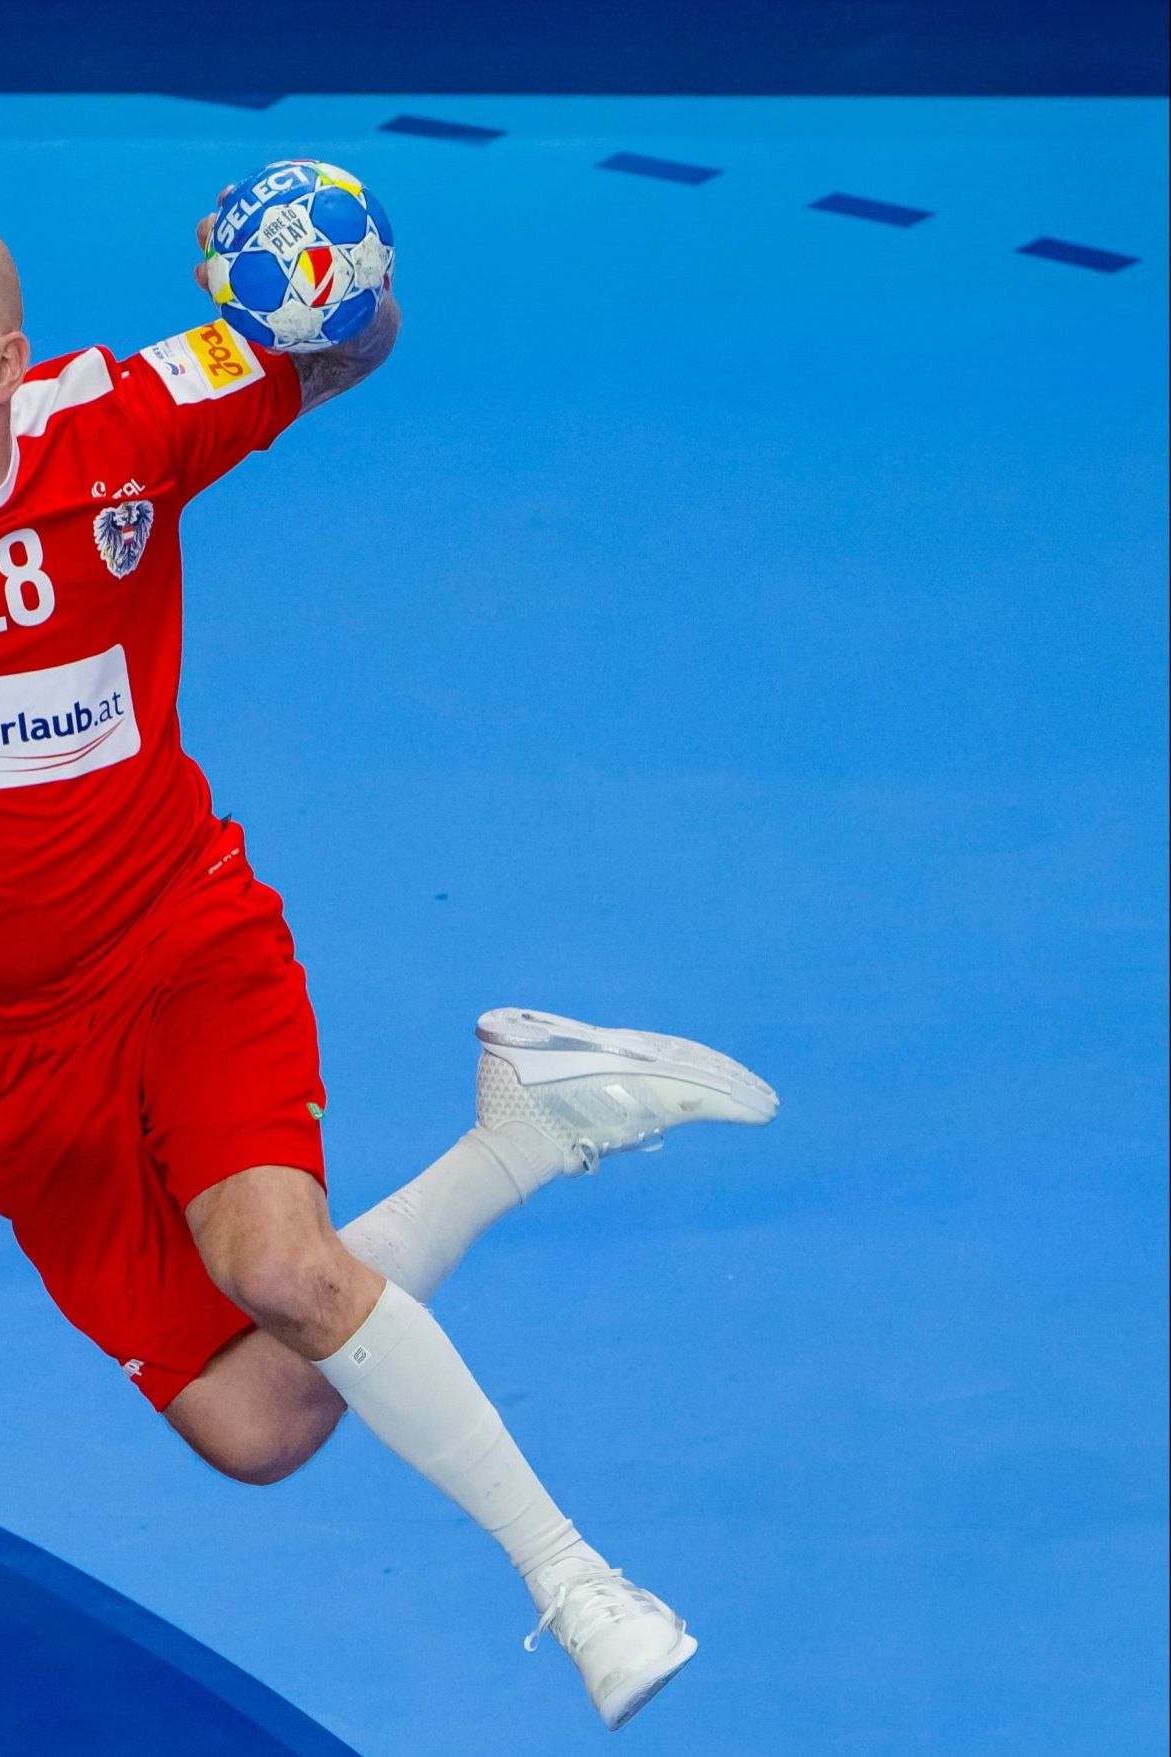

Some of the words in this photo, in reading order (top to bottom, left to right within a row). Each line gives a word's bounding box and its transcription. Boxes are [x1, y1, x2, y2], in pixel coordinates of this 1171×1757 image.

[216, 165, 310, 249] SELECT
[263, 217, 286, 240] HERE
[272, 218, 308, 254] PLAY
